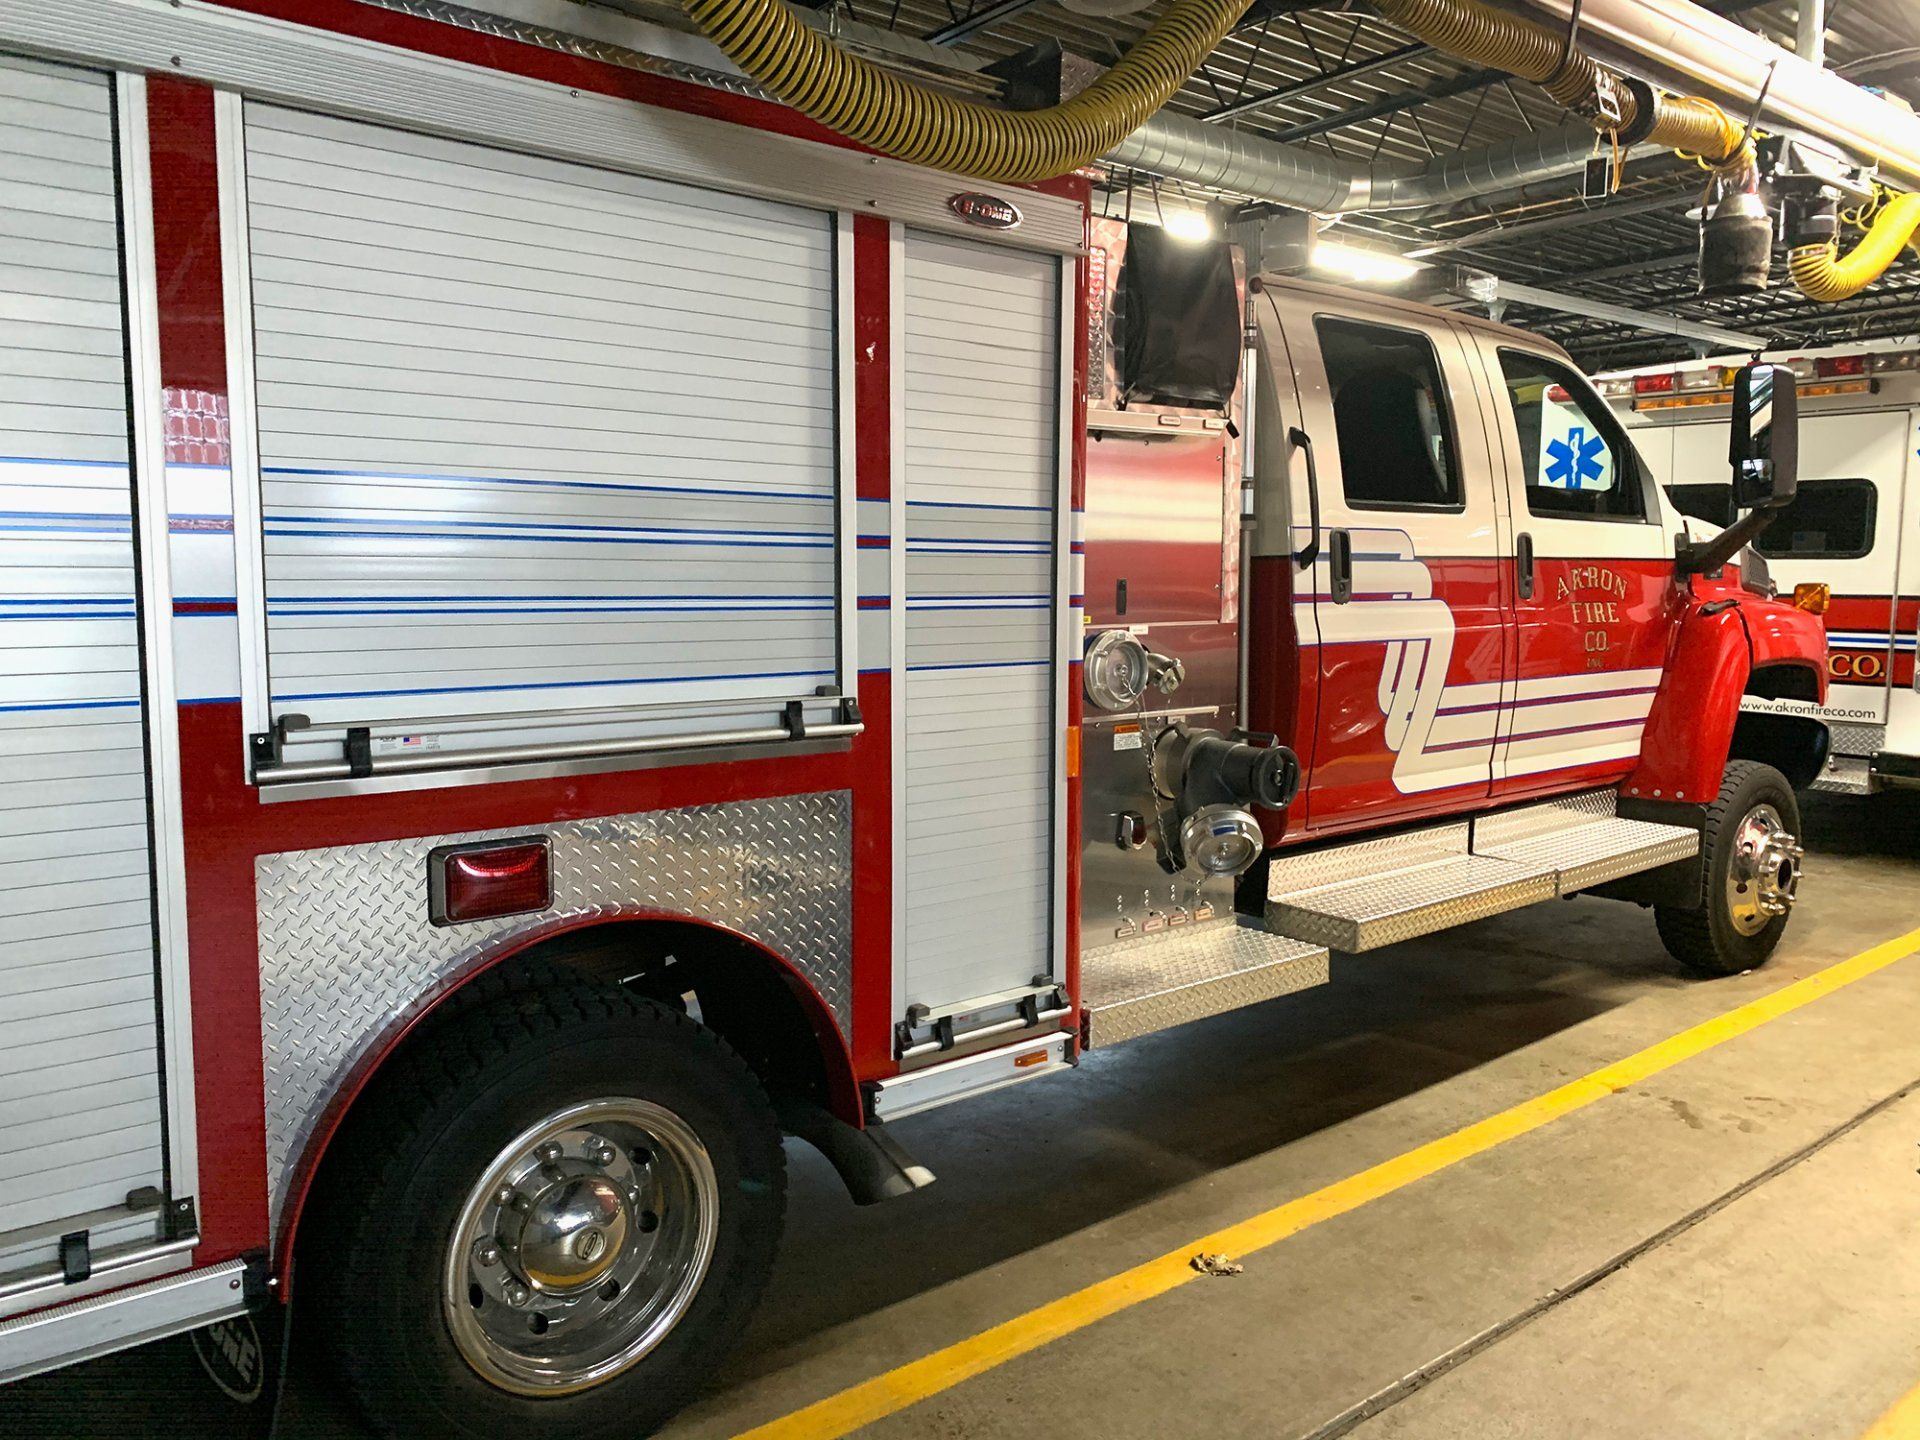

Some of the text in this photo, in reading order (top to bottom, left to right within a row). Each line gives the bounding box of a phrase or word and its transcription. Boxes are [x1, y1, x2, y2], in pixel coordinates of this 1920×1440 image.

[1557, 566, 1628, 600] AKRON
[1571, 602, 1620, 624] FIRE
[1828, 653, 1886, 677] CO.
[1740, 702, 1876, 719] www.akronfireco.com
